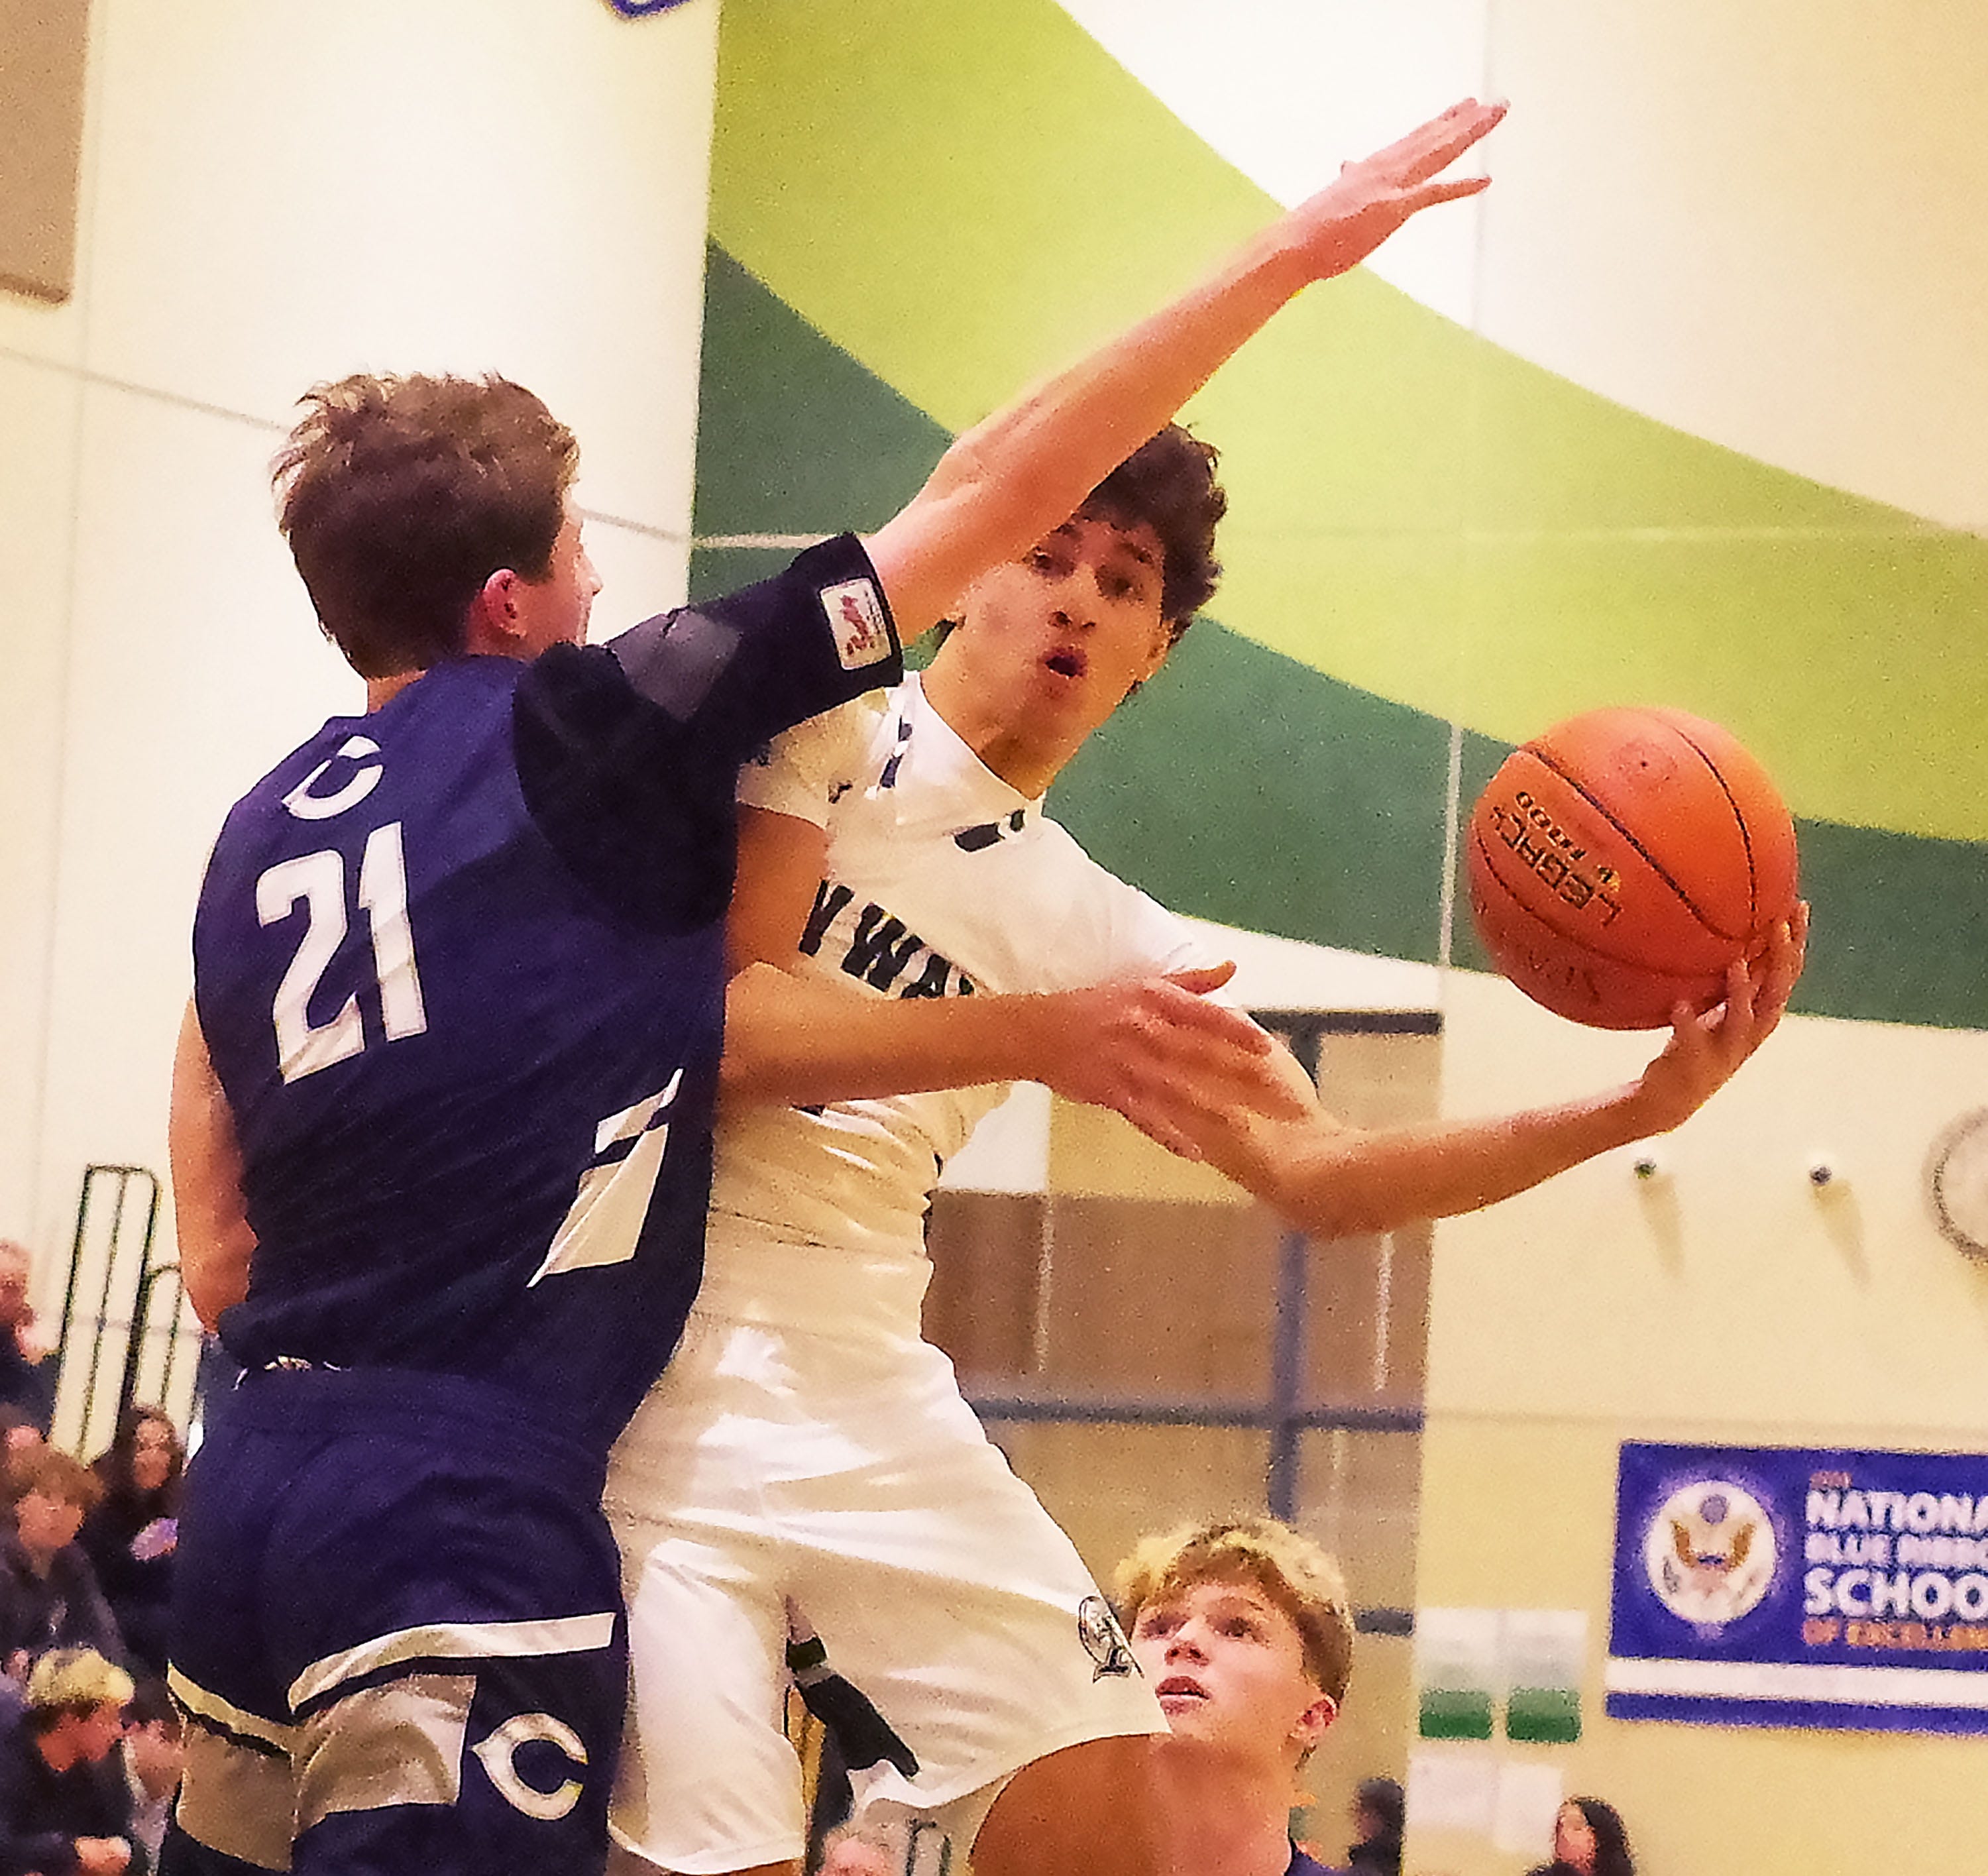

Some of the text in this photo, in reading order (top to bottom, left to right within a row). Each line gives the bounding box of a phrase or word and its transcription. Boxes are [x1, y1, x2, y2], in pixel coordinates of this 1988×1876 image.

[281, 735, 384, 821] C
[256, 820, 429, 1085] 21
[799, 877, 976, 1000] YWA
[470, 1712, 590, 1821] C
